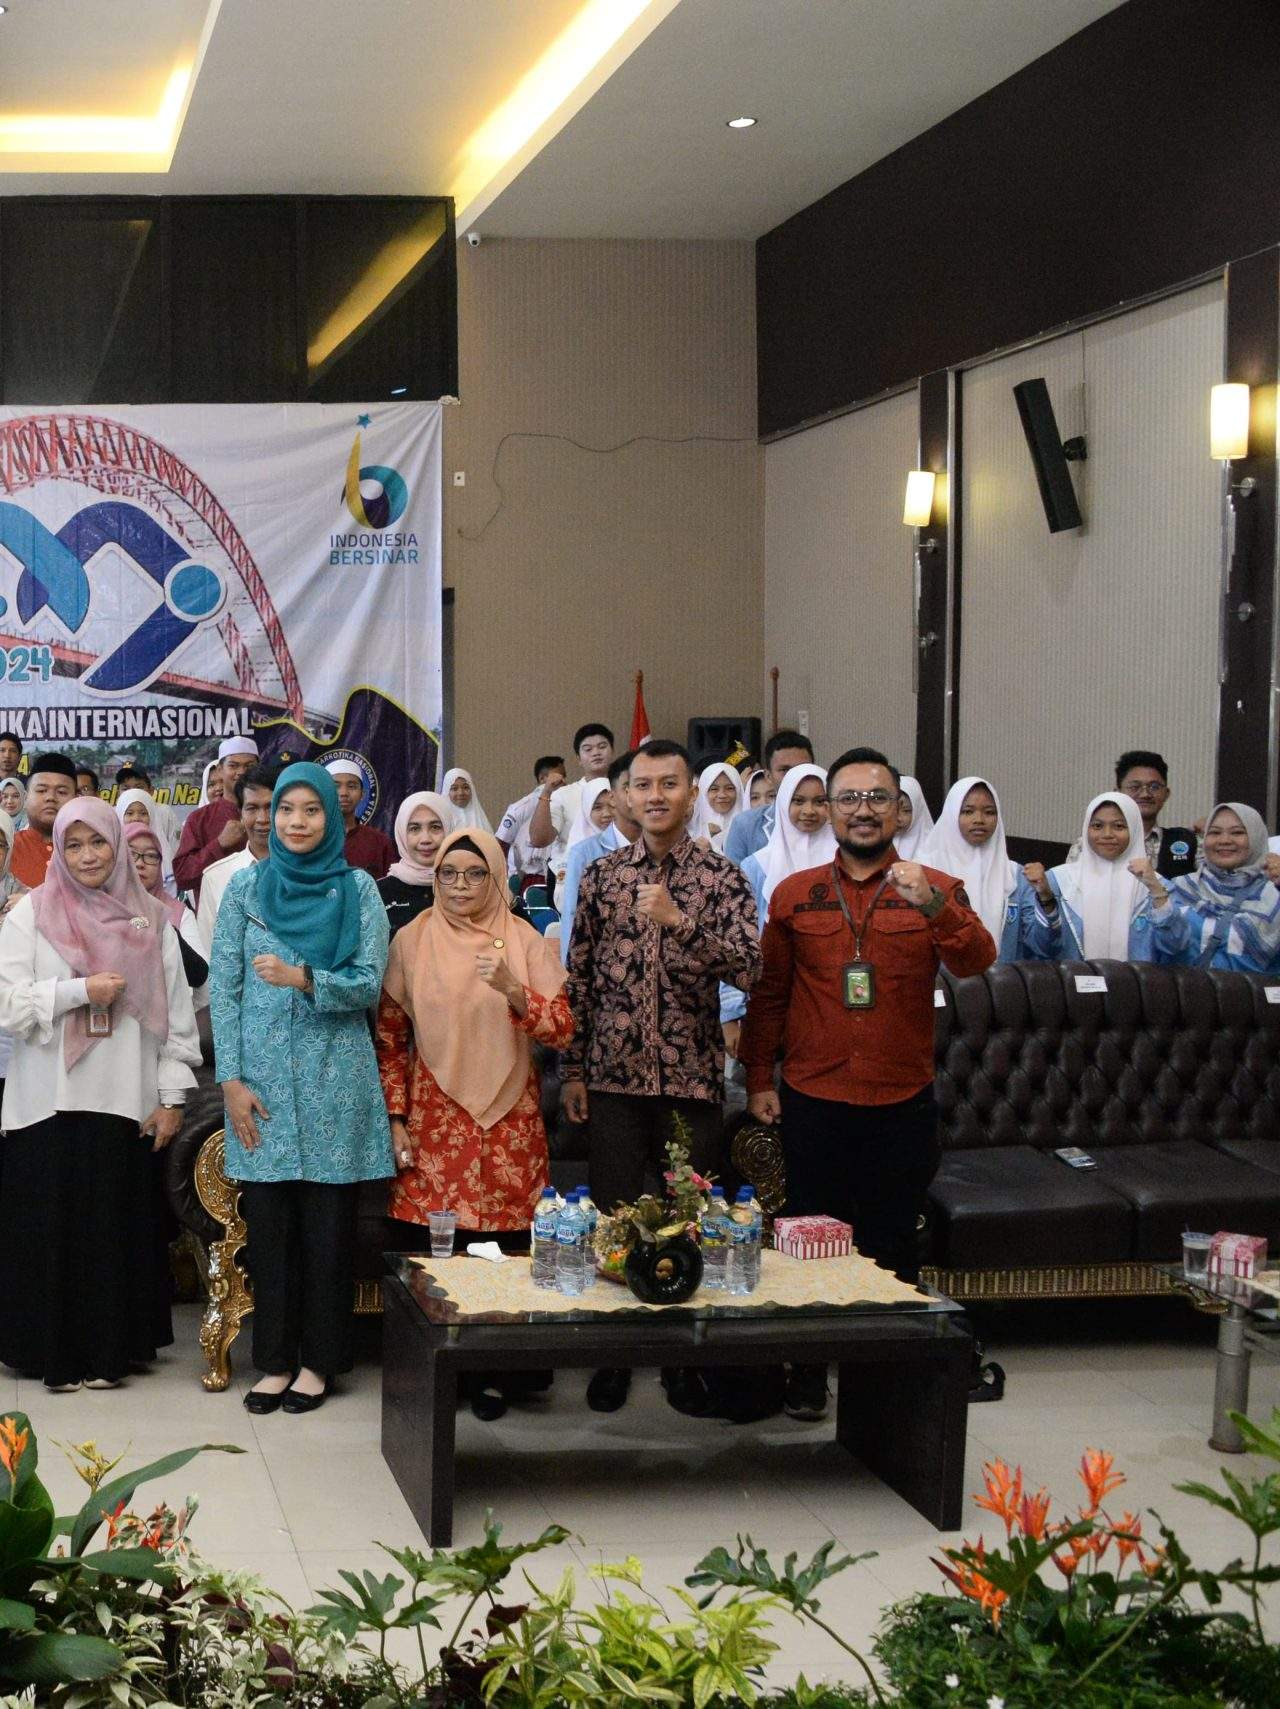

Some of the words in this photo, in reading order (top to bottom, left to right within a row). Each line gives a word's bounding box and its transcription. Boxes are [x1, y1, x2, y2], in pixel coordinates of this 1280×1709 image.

[330, 533, 418, 548] INDONESIA
[329, 550, 419, 565] BERSINAR
[49, 707, 255, 738] INTERNASIONAL
[318, 752, 354, 765] ARKOTIKA
